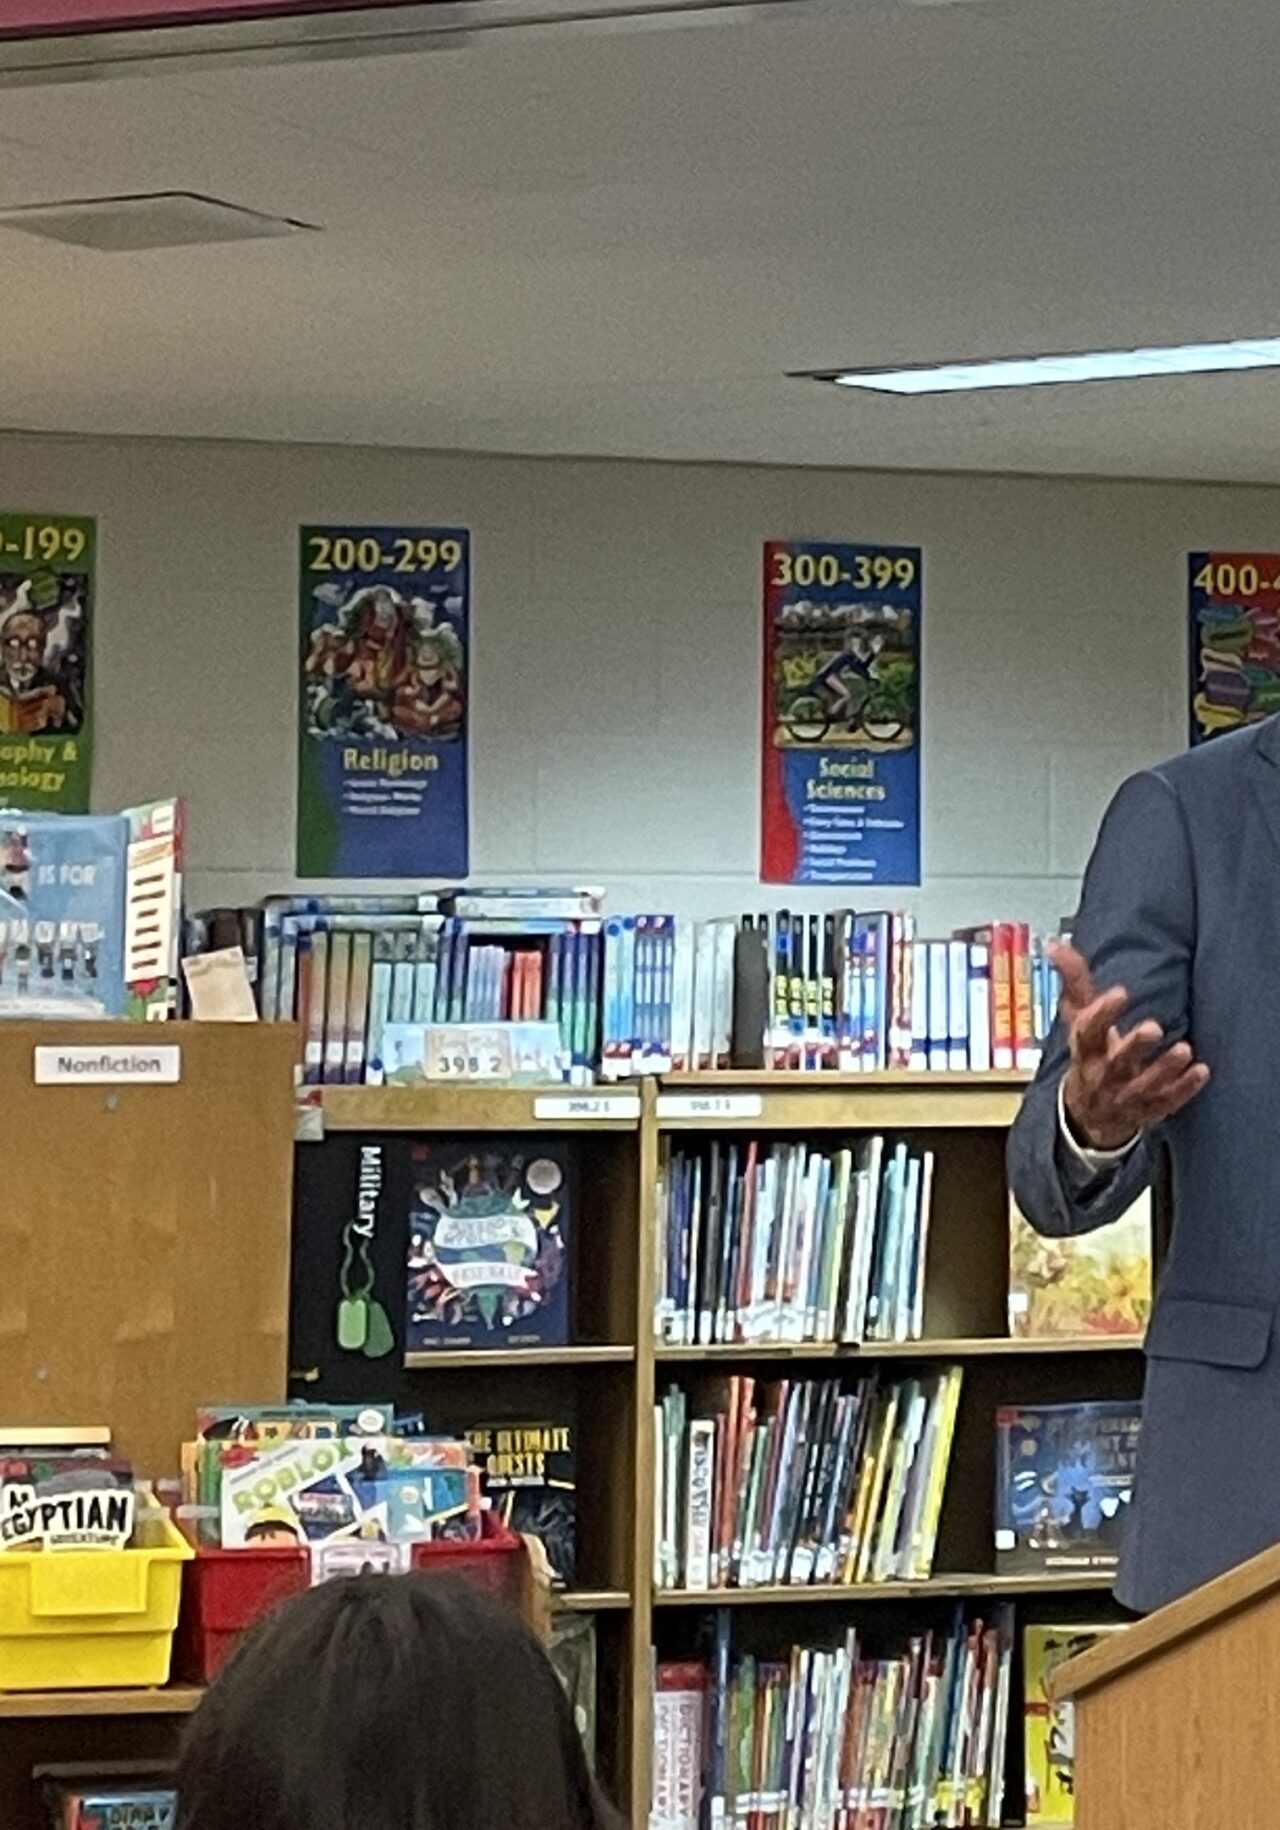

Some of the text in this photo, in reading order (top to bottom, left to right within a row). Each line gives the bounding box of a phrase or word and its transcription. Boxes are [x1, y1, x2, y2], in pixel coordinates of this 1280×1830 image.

[0, 526, 86, 561] -199
[308, 537, 462, 573] 200-299
[771, 554, 915, 589] 300-399
[0, 738, 56, 765] ophy
[343, 747, 439, 777] Religion
[819, 757, 875, 778] Social
[806, 779, 886, 801] Sciences
[57, 1055, 162, 1073] Nonfiction
[352, 1146, 382, 1239] Military
[231, 1439, 355, 1515] ROBLOX
[1, 1496, 129, 1542] EGYPTIAN
